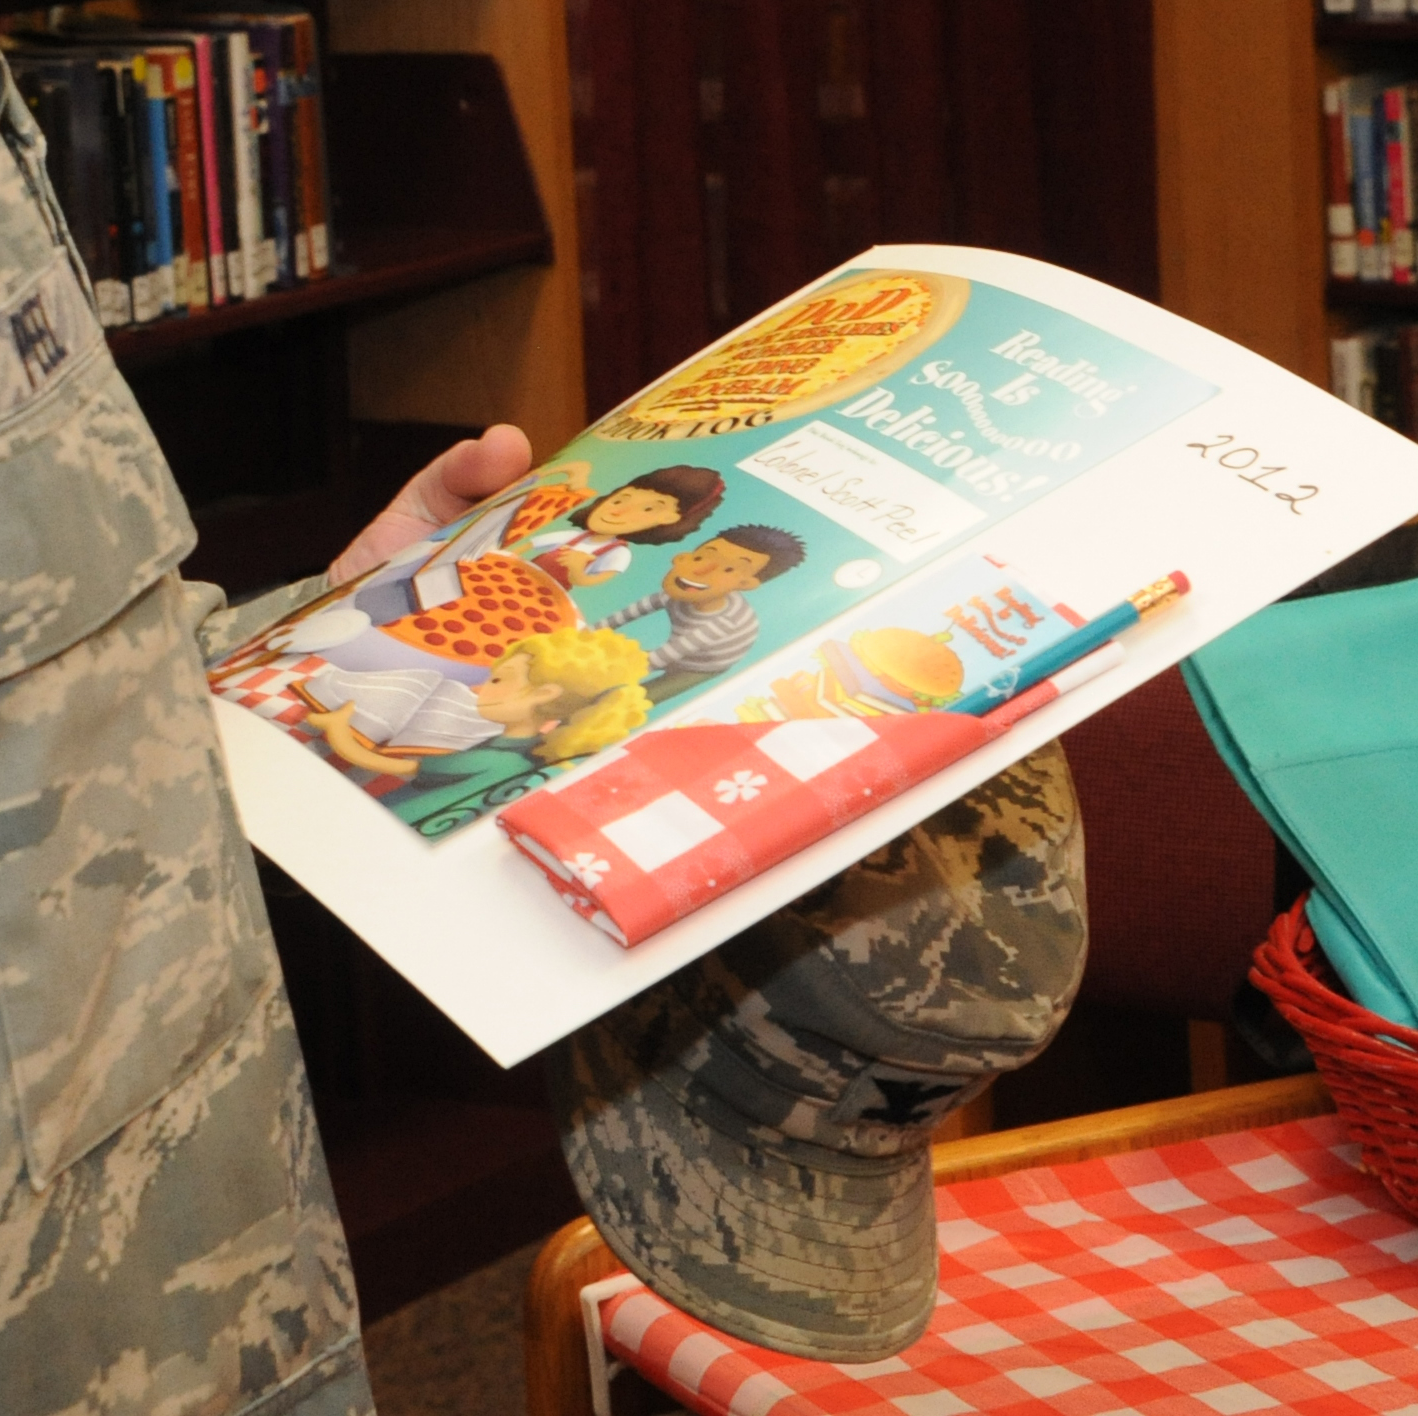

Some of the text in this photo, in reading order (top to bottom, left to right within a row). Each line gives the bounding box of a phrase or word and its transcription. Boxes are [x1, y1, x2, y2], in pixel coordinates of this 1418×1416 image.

[988, 328, 1138, 420] Reading
[989, 372, 1042, 406] Is
[834, 386, 1050, 503] Delicious!
[1185, 434, 1322, 517] 2012
[820, 477, 888, 514] Scott
[871, 504, 941, 546] Peel
